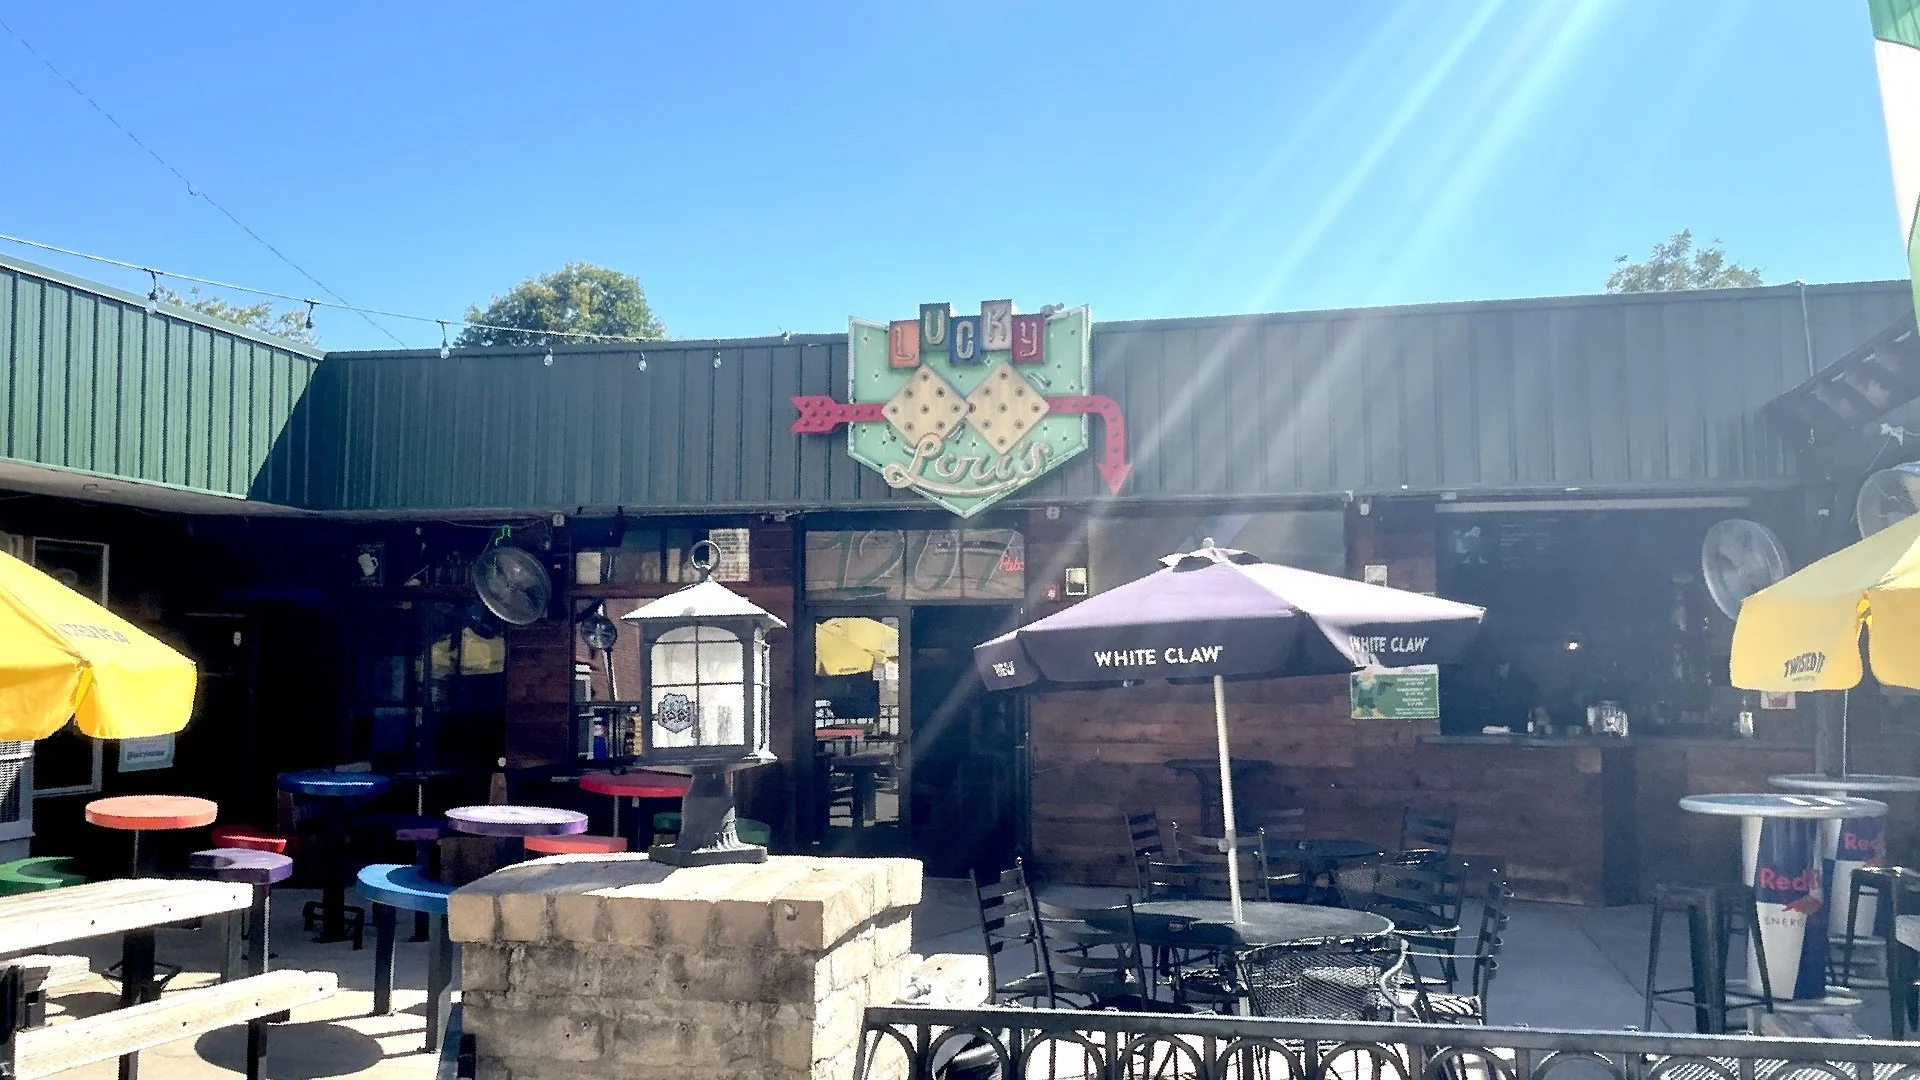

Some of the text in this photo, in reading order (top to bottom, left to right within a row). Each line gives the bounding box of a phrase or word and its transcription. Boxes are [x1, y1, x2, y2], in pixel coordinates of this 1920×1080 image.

[896, 307, 1038, 360] LUCKY
[804, 528, 1018, 600] 1207
[1094, 645, 1221, 667] WHITE CLAW
[1349, 636, 1427, 653] WHITE CLAW
[1760, 867, 1813, 891] Red
